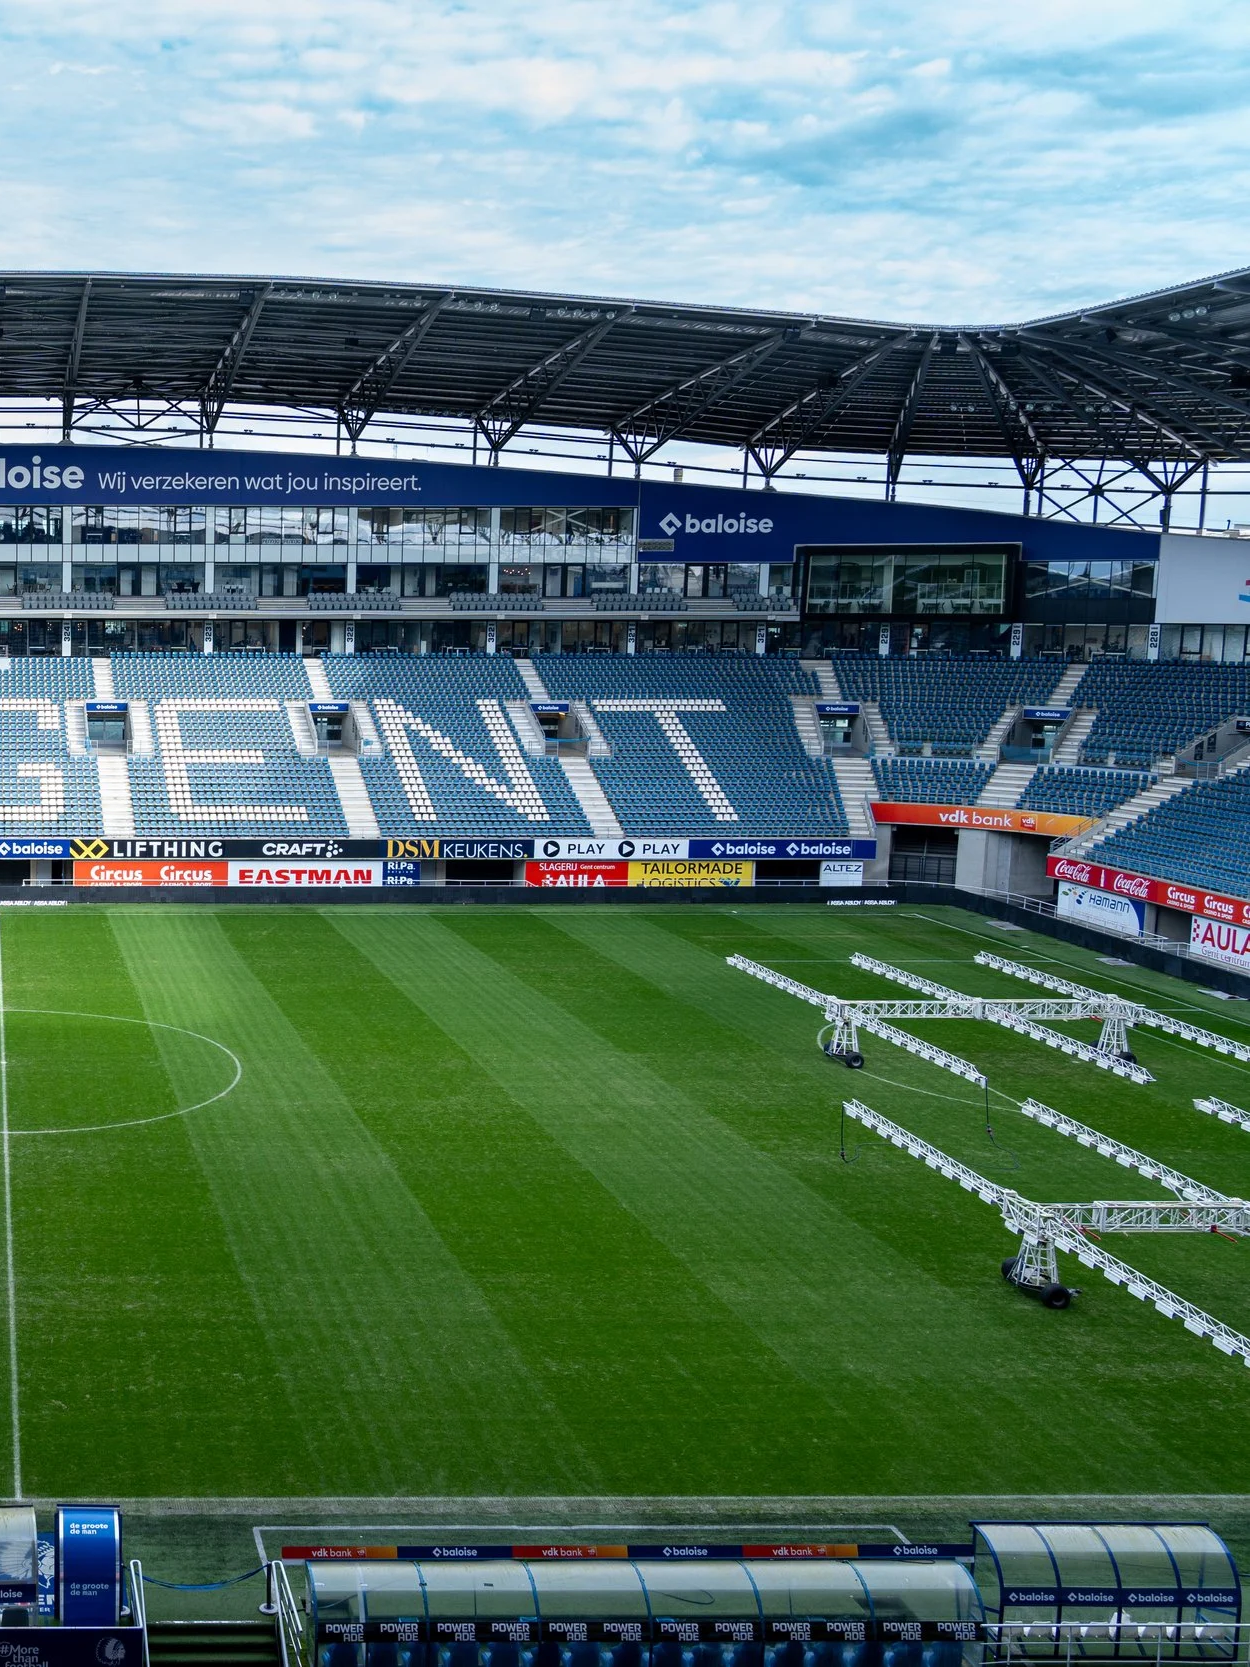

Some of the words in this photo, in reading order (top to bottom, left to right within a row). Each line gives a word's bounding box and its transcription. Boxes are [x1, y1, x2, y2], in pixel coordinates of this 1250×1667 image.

[98, 472, 126, 493] Wij
[131, 471, 240, 491] verzekeren
[244, 473, 283, 491] wat
[285, 472, 318, 494] jou
[324, 471, 422, 494] inspireert.
[685, 512, 774, 534] baloise
[939, 810, 969, 824] vdk
[972, 812, 1012, 827] bank
[12, 841, 63, 855] baloise
[113, 841, 223, 858] LIFTHING
[262, 843, 326, 856] CRAFT
[386, 839, 440, 859] DSM
[567, 843, 606, 855] PLAY
[642, 843, 680, 855] PLAY
[726, 842, 776, 855] baloise
[801, 842, 851, 855] baloise
[539, 862, 578, 871] SLAGERIJ
[641, 862, 743, 874] TAILORMADE
[823, 864, 862, 873] ALTEZ
[90, 865, 143, 880] Circus
[159, 865, 213, 880] Circus
[238, 869, 372, 885] EASTMAN
[1167, 886, 1196, 904] Circus
[1204, 895, 1234, 914] Circus
[81, 1523, 109, 1531] groote
[311, 1548, 328, 1558] vdk
[329, 1548, 352, 1558] bank
[443, 1547, 478, 1558] baloise
[542, 1548, 559, 1557] vdk
[559, 1548, 583, 1557] bank
[673, 1546, 708, 1557] baloise
[772, 1547, 789, 1556] vdk
[791, 1547, 813, 1556] bank
[903, 1545, 938, 1555] baloise
[82, 1583, 110, 1591] groote
[1019, 1592, 1055, 1602] baloise
[1078, 1592, 1114, 1602] baloise
[1138, 1592, 1174, 1603] baloise
[1197, 1593, 1234, 1603] baloise
[325, 1623, 364, 1633] POWER
[660, 1622, 699, 1632] POWER
[937, 1622, 976, 1632] POWER
[343, 1632, 364, 1642] ADE
[678, 1631, 699, 1641] ADE
[955, 1631, 976, 1641] ADE
[13, 1654, 39, 1663] than
